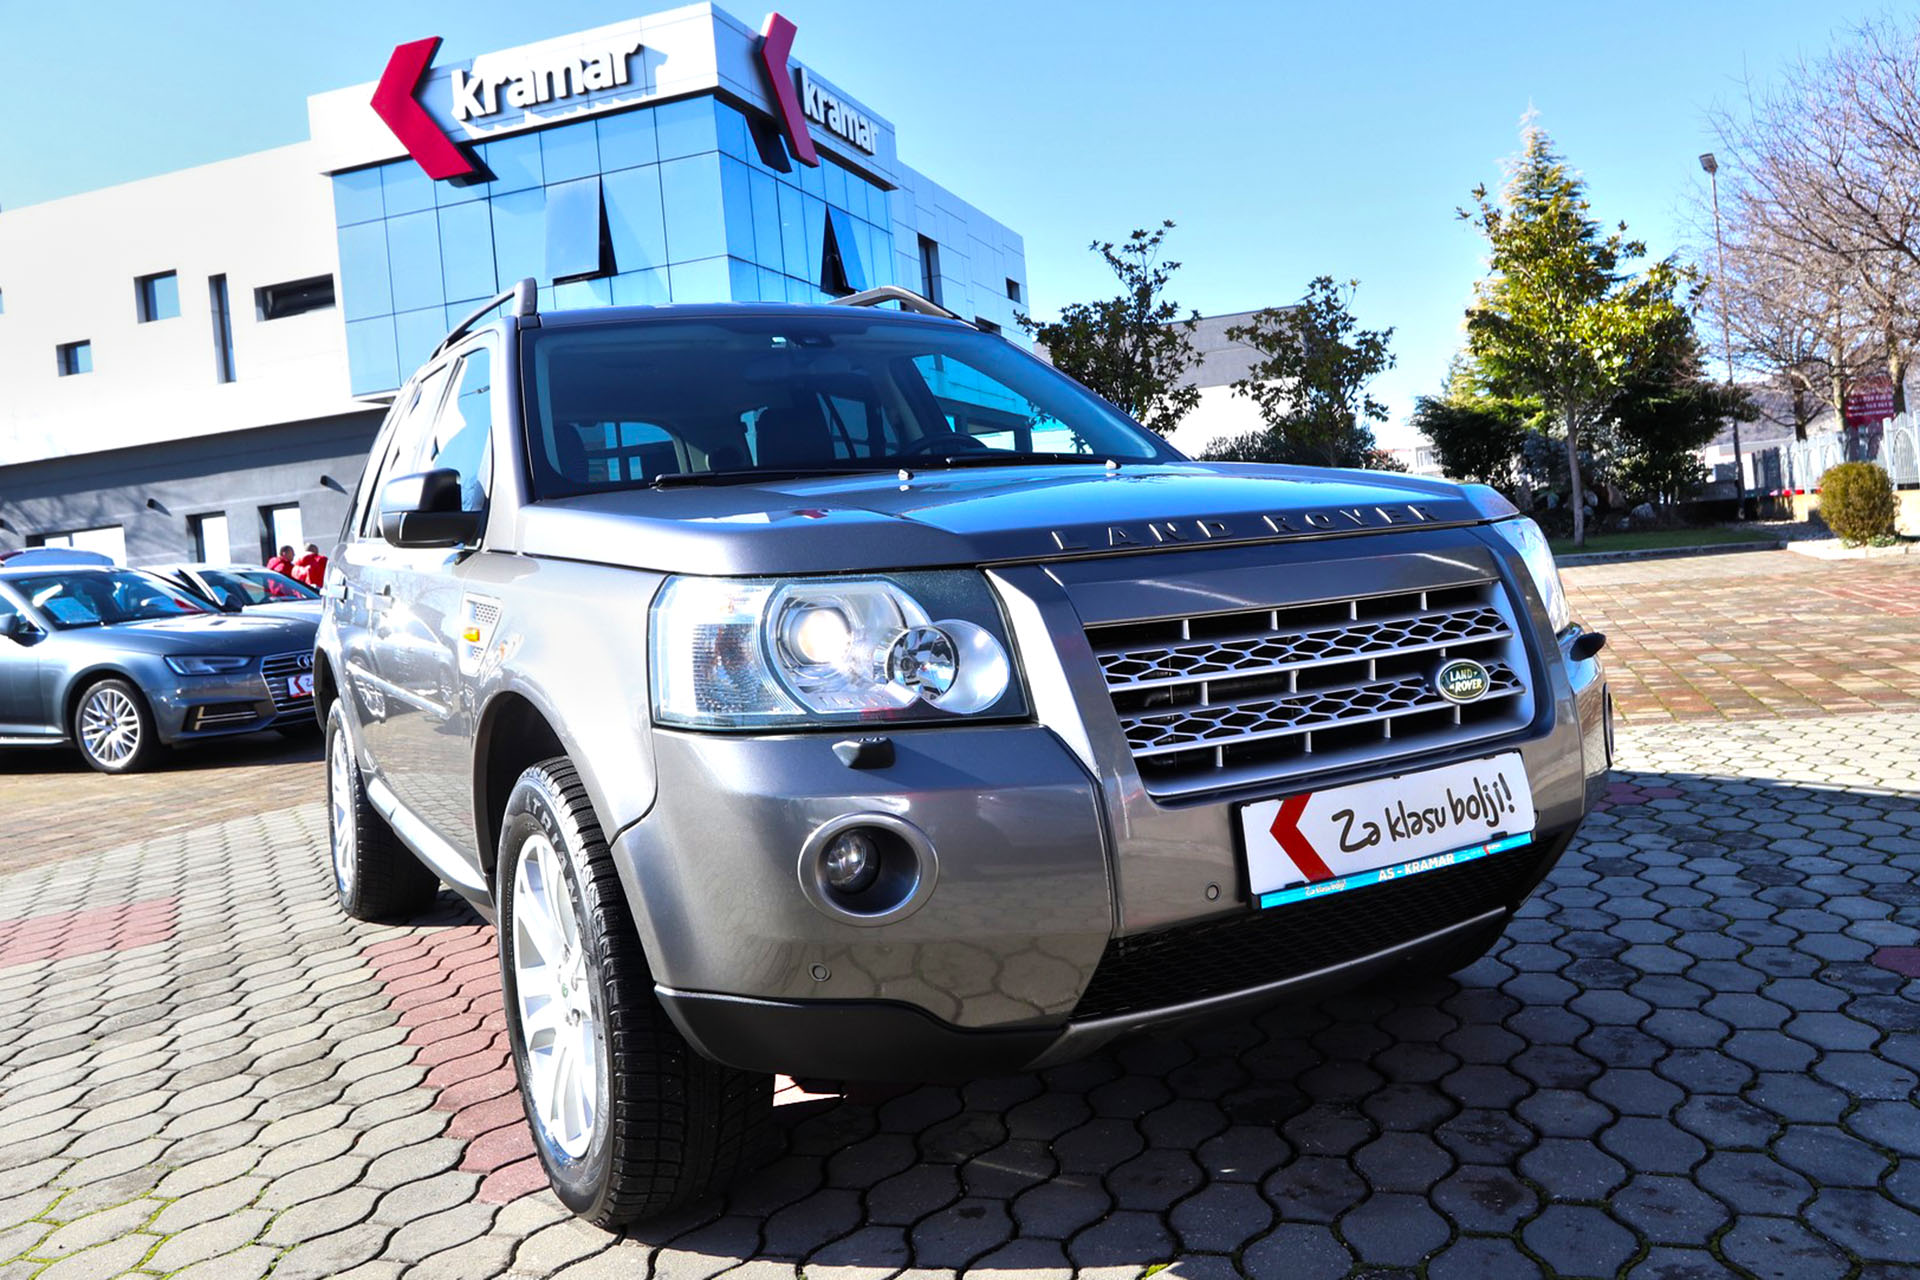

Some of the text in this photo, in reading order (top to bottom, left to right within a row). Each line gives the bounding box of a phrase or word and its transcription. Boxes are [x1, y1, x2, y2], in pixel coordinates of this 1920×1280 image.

[451, 43, 642, 121] kramar
[801, 67, 879, 155] kramar
[1051, 504, 1440, 550] LAND ROVER
[1450, 669, 1482, 693] LAND ROVER
[1331, 772, 1515, 853] Za klasu bolji!
[1378, 867, 1395, 881] AS
[1404, 853, 1455, 875] KRAMAR
